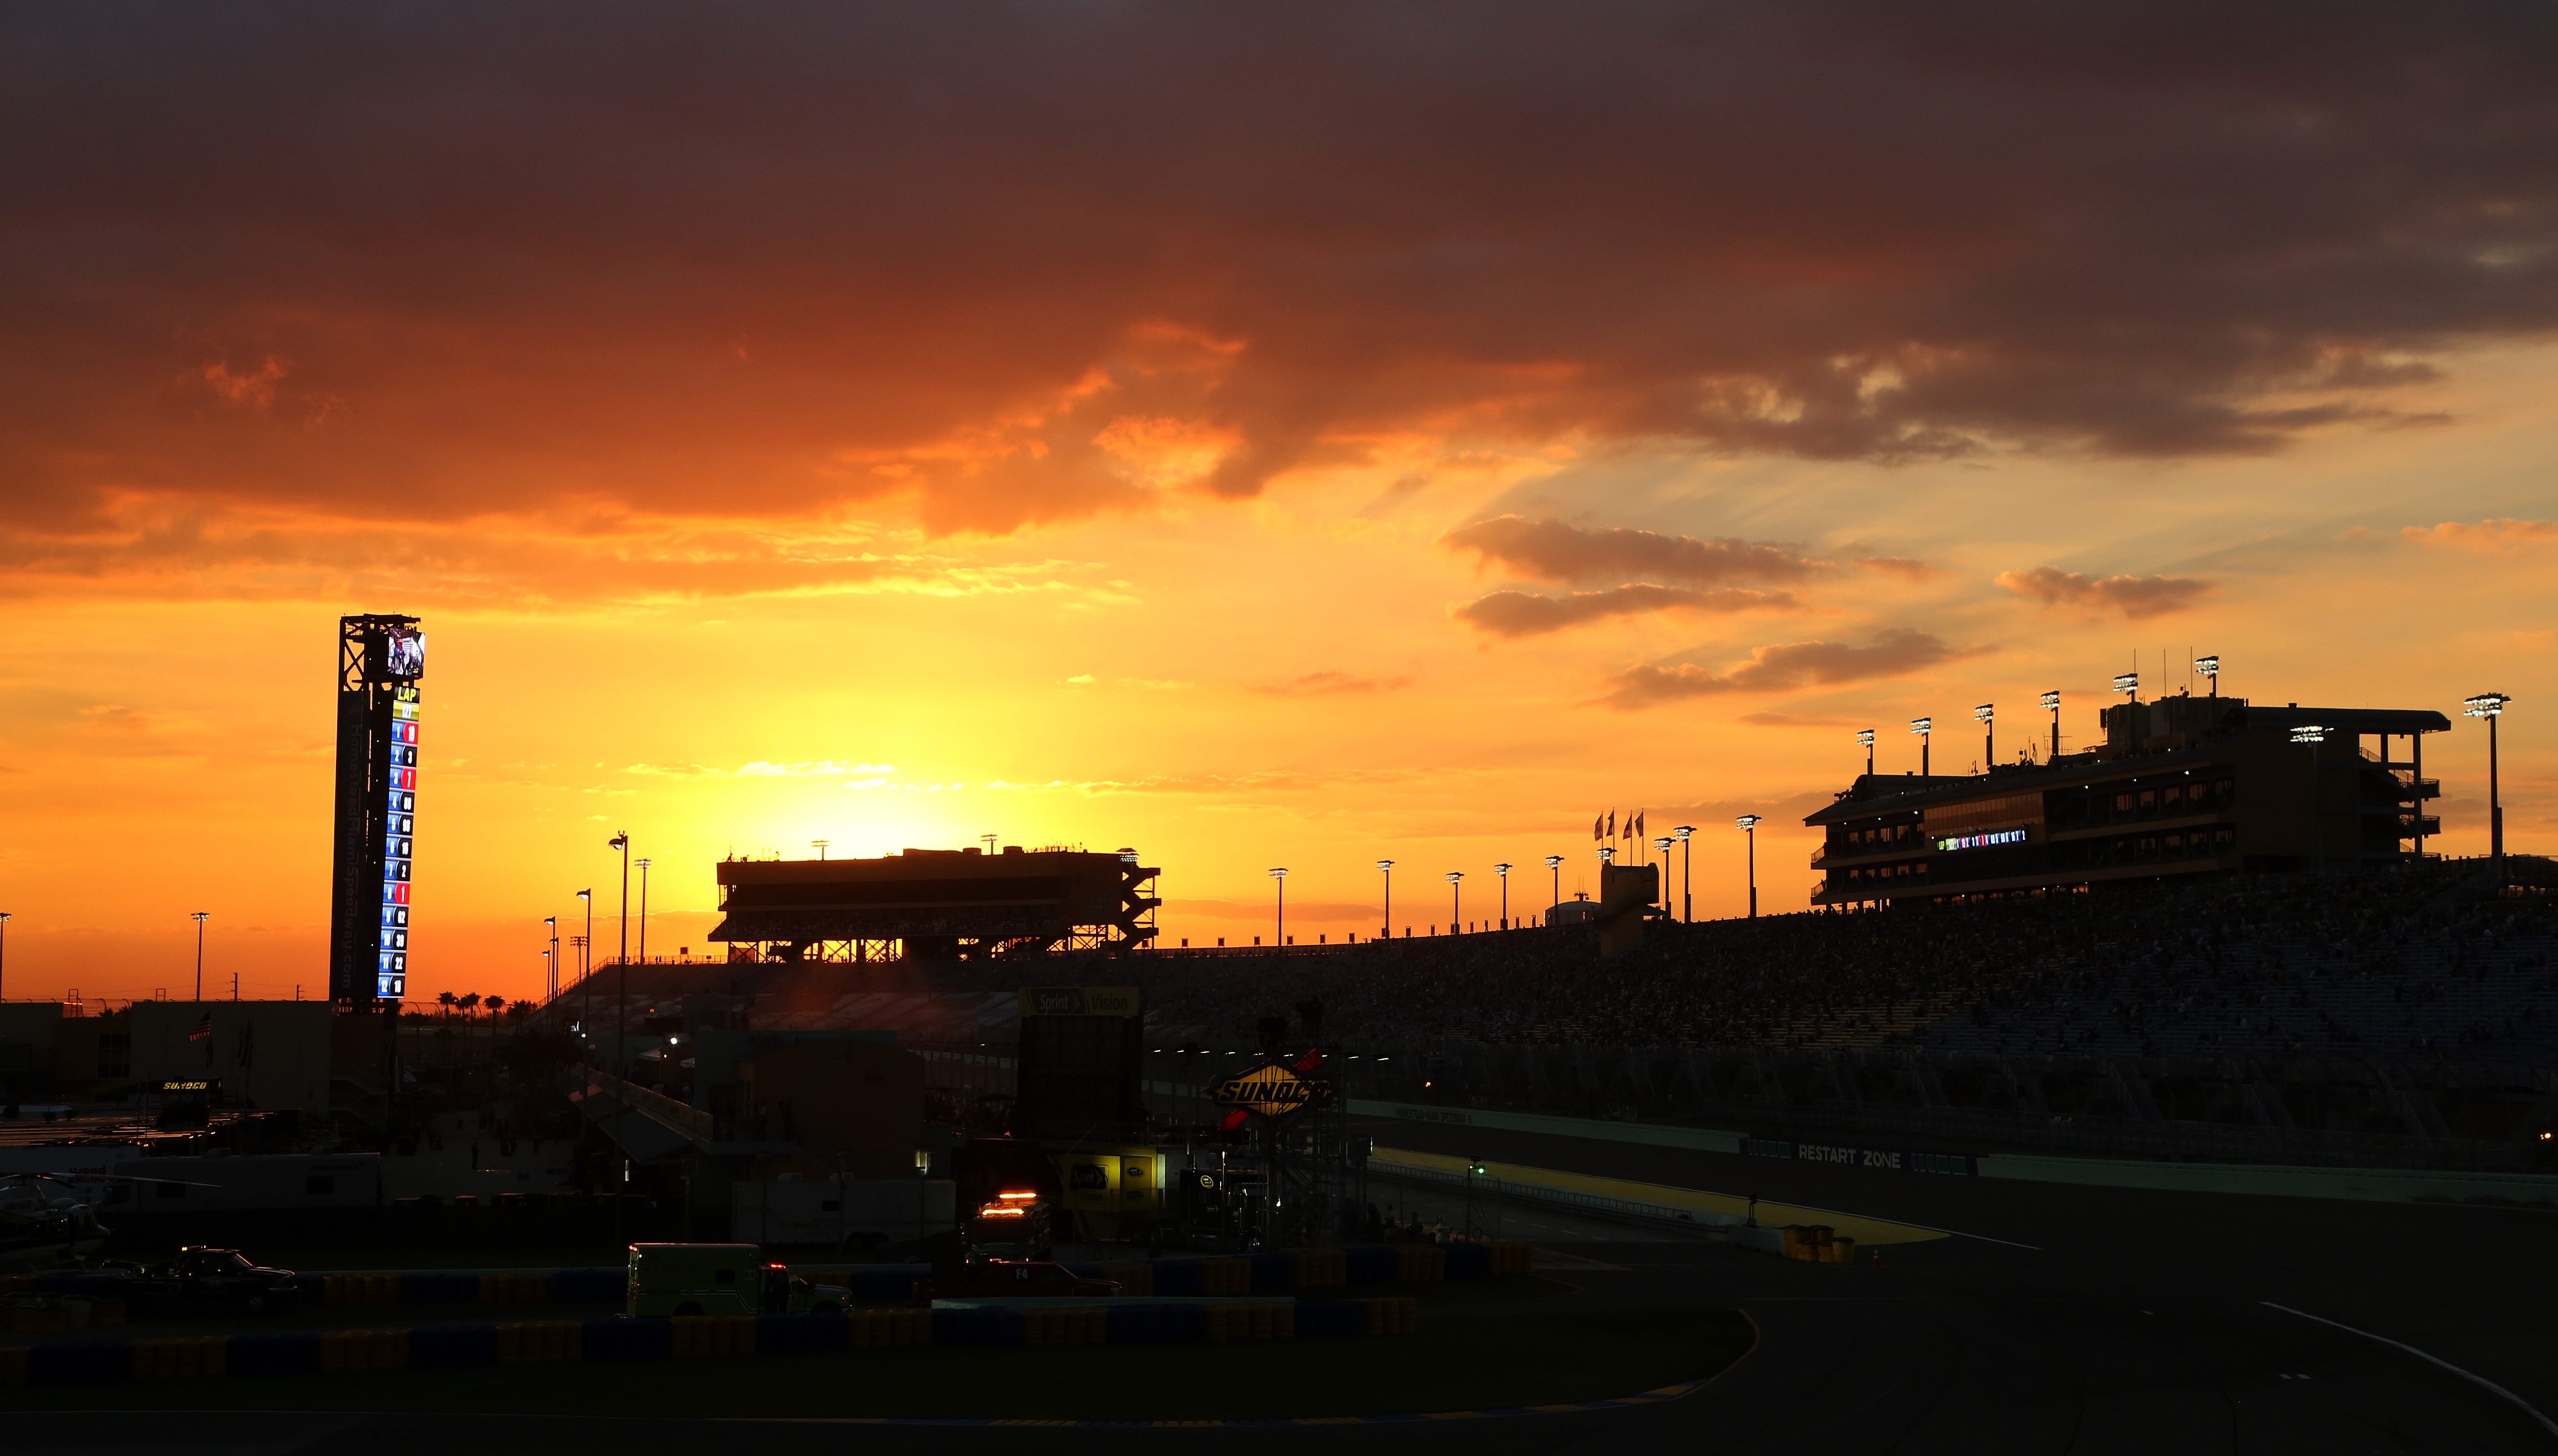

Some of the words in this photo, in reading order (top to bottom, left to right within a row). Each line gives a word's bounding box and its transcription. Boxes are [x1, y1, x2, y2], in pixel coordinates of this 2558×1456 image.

[398, 686, 416, 702] LAP
[402, 704, 412, 719] 127
[397, 726, 400, 738] 1
[395, 749, 399, 762] 2
[394, 772, 398, 784] 3
[392, 796, 397, 808] 4
[391, 818, 396, 831] 5
[390, 841, 395, 854] 6
[402, 864, 407, 878] 2
[387, 887, 392, 900] 8
[401, 886, 405, 902] 1
[386, 910, 391, 923] 9
[398, 910, 406, 924] 62
[384, 933, 391, 946] 10
[396, 934, 405, 948] 39
[383, 956, 389, 969] 11
[395, 956, 403, 970] 22
[381, 980, 388, 993] 12
[394, 980, 402, 993] 18
[1040, 994, 1069, 1014] Sprint
[1092, 994, 1128, 1010] Vision
[1219, 1082, 1328, 1102] SUNOC
[1798, 1144, 1856, 1164] RESTART
[1863, 1150, 1901, 1169] ZONE
[745, 1271, 754, 1279] R4
[1016, 1269, 1028, 1279] F4
